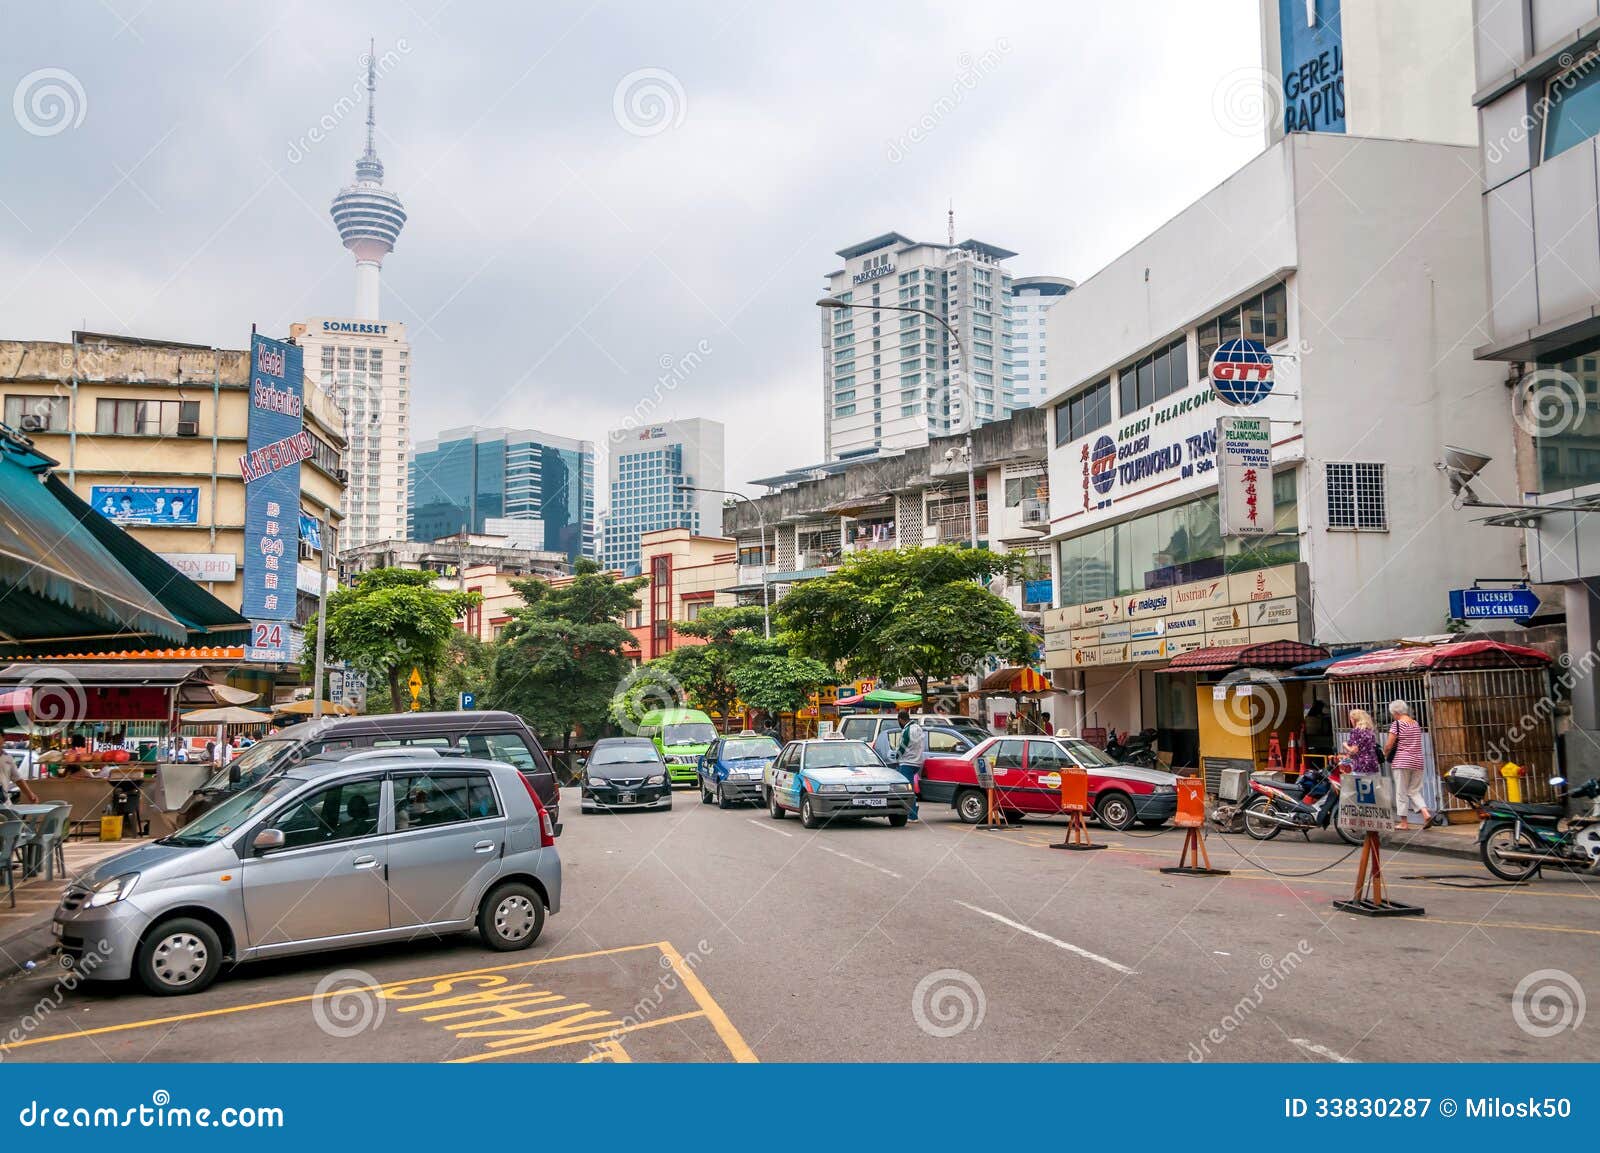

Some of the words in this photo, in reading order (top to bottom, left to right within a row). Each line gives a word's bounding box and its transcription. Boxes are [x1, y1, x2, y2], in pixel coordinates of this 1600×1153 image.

[323, 321, 388, 334] SOMERSET
[1213, 362, 1274, 381] GTT
[1118, 416, 1151, 442] AGENSI
[1225, 431, 1269, 441] PELANCONGAN
[1118, 434, 1150, 460] GOLDEN
[1225, 447, 1270, 455] TOURWORLD
[1091, 453, 1117, 477] GTT
[1117, 442, 1182, 487] TOURWORLD
[1242, 455, 1269, 463] TRAVEL
[205, 559, 232, 573] BHD
[1176, 588, 1208, 603] Austrian
[1250, 591, 1273, 601] Emirates
[1477, 592, 1514, 602] LICENSED
[1138, 594, 1168, 611] malaysia
[1267, 608, 1292, 618] EXPRESS
[1465, 605, 1490, 615] MONEY
[1492, 604, 1529, 615] CHANGER
[256, 624, 282, 648] 24
[1082, 650, 1097, 663] THAI
[345, 681, 365, 690] DEEN
[862, 683, 873, 693] 24
[464, 695, 473, 705] P
[1358, 779, 1372, 802] P
[1340, 804, 1358, 816] HOTEL
[1359, 806, 1379, 818] GUESTS
